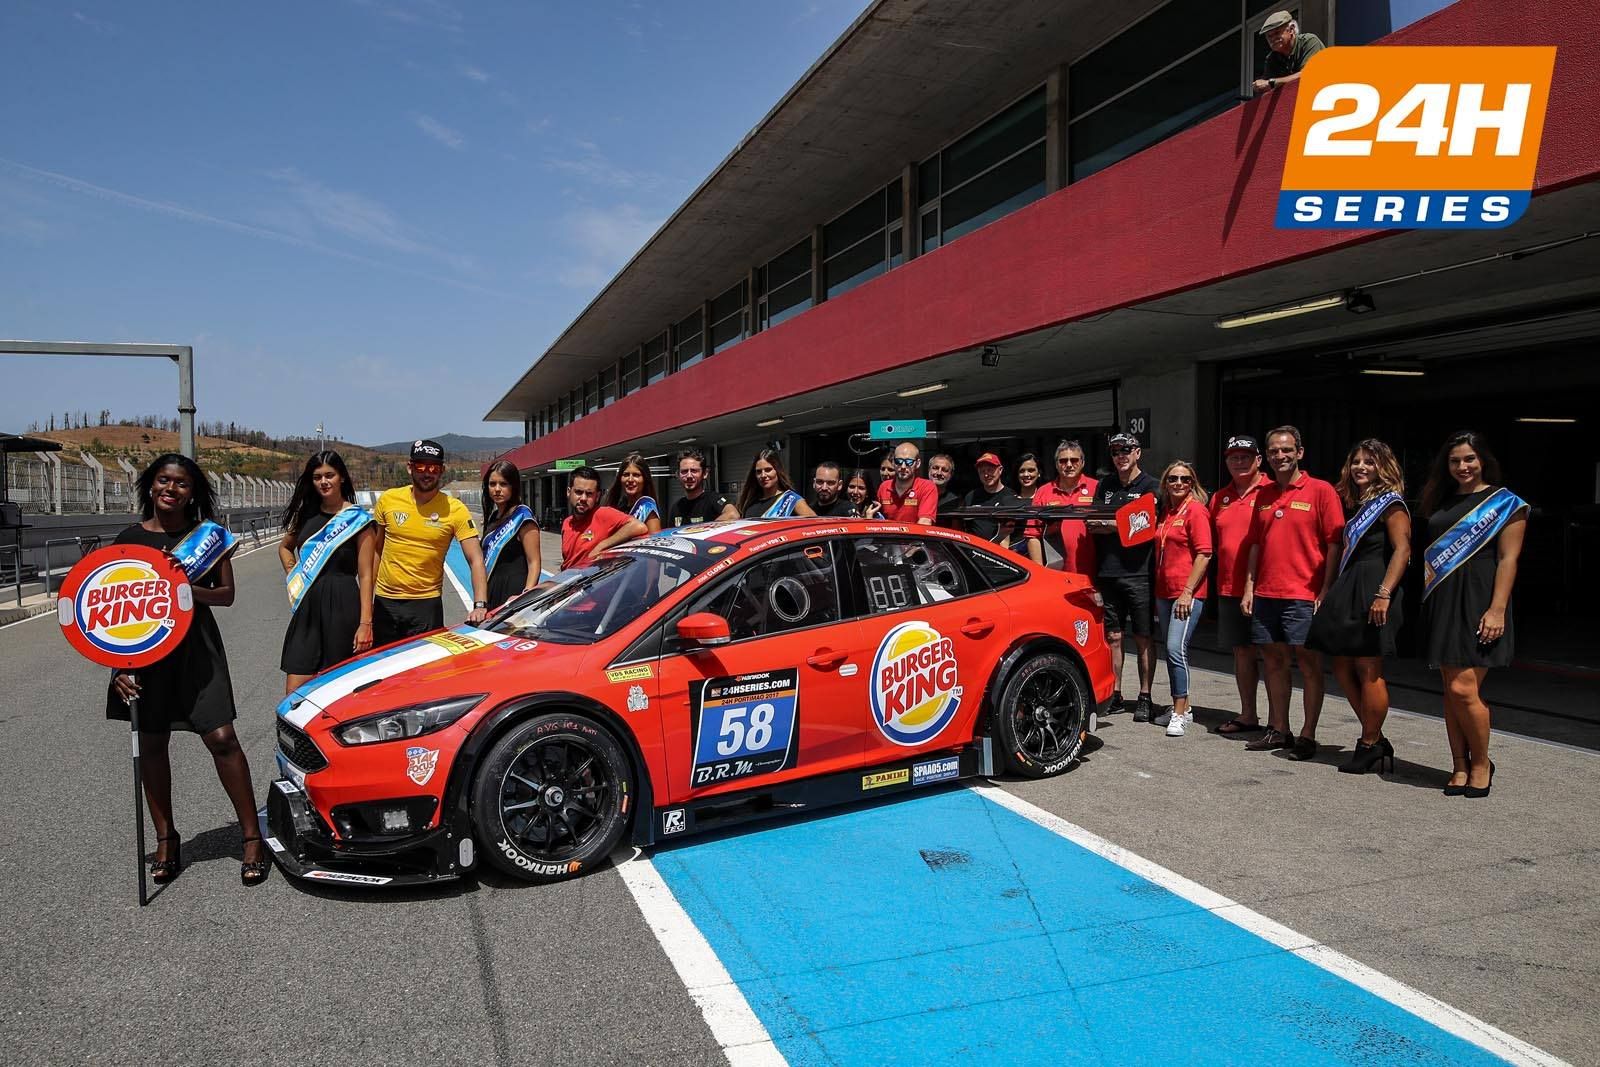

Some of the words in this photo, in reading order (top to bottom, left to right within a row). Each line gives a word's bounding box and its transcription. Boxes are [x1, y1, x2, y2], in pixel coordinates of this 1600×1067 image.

[1130, 417, 1145, 434] 30
[1431, 508, 1499, 570] SERIES.COM
[87, 580, 168, 607] BURGER
[87, 597, 169, 631] KING
[624, 667, 648, 675] RACING
[881, 639, 953, 693] BURGER
[722, 679, 791, 696] 24HSERIES.COM
[884, 660, 957, 724] KING
[716, 703, 775, 756] 58
[408, 760, 435, 775] FOCUS
[409, 751, 437, 767] STAY
[876, 771, 907, 782] PANINI
